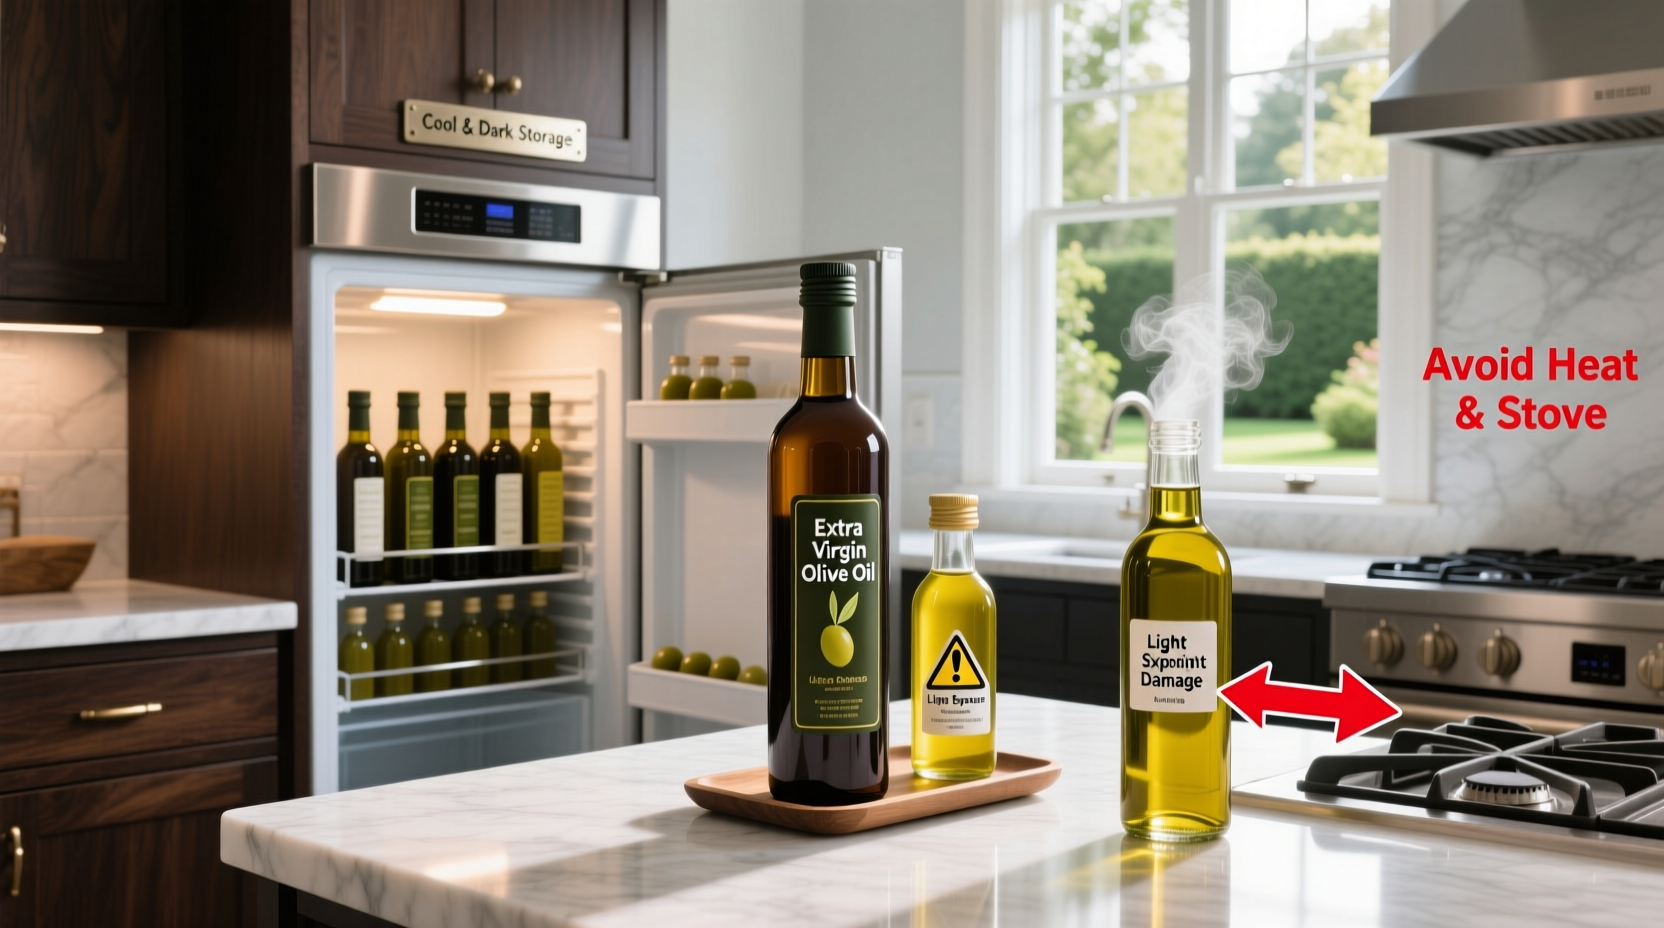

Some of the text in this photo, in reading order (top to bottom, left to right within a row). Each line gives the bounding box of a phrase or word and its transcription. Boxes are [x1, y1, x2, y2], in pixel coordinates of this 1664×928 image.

[422, 113, 573, 149] Cool & Dark Storage
[814, 518, 863, 537] Extra
[811, 540, 867, 564] Virgin
[801, 561, 875, 583] Olive Oil
[1147, 633, 1187, 654] Light
[1141, 671, 1203, 692] Damage
